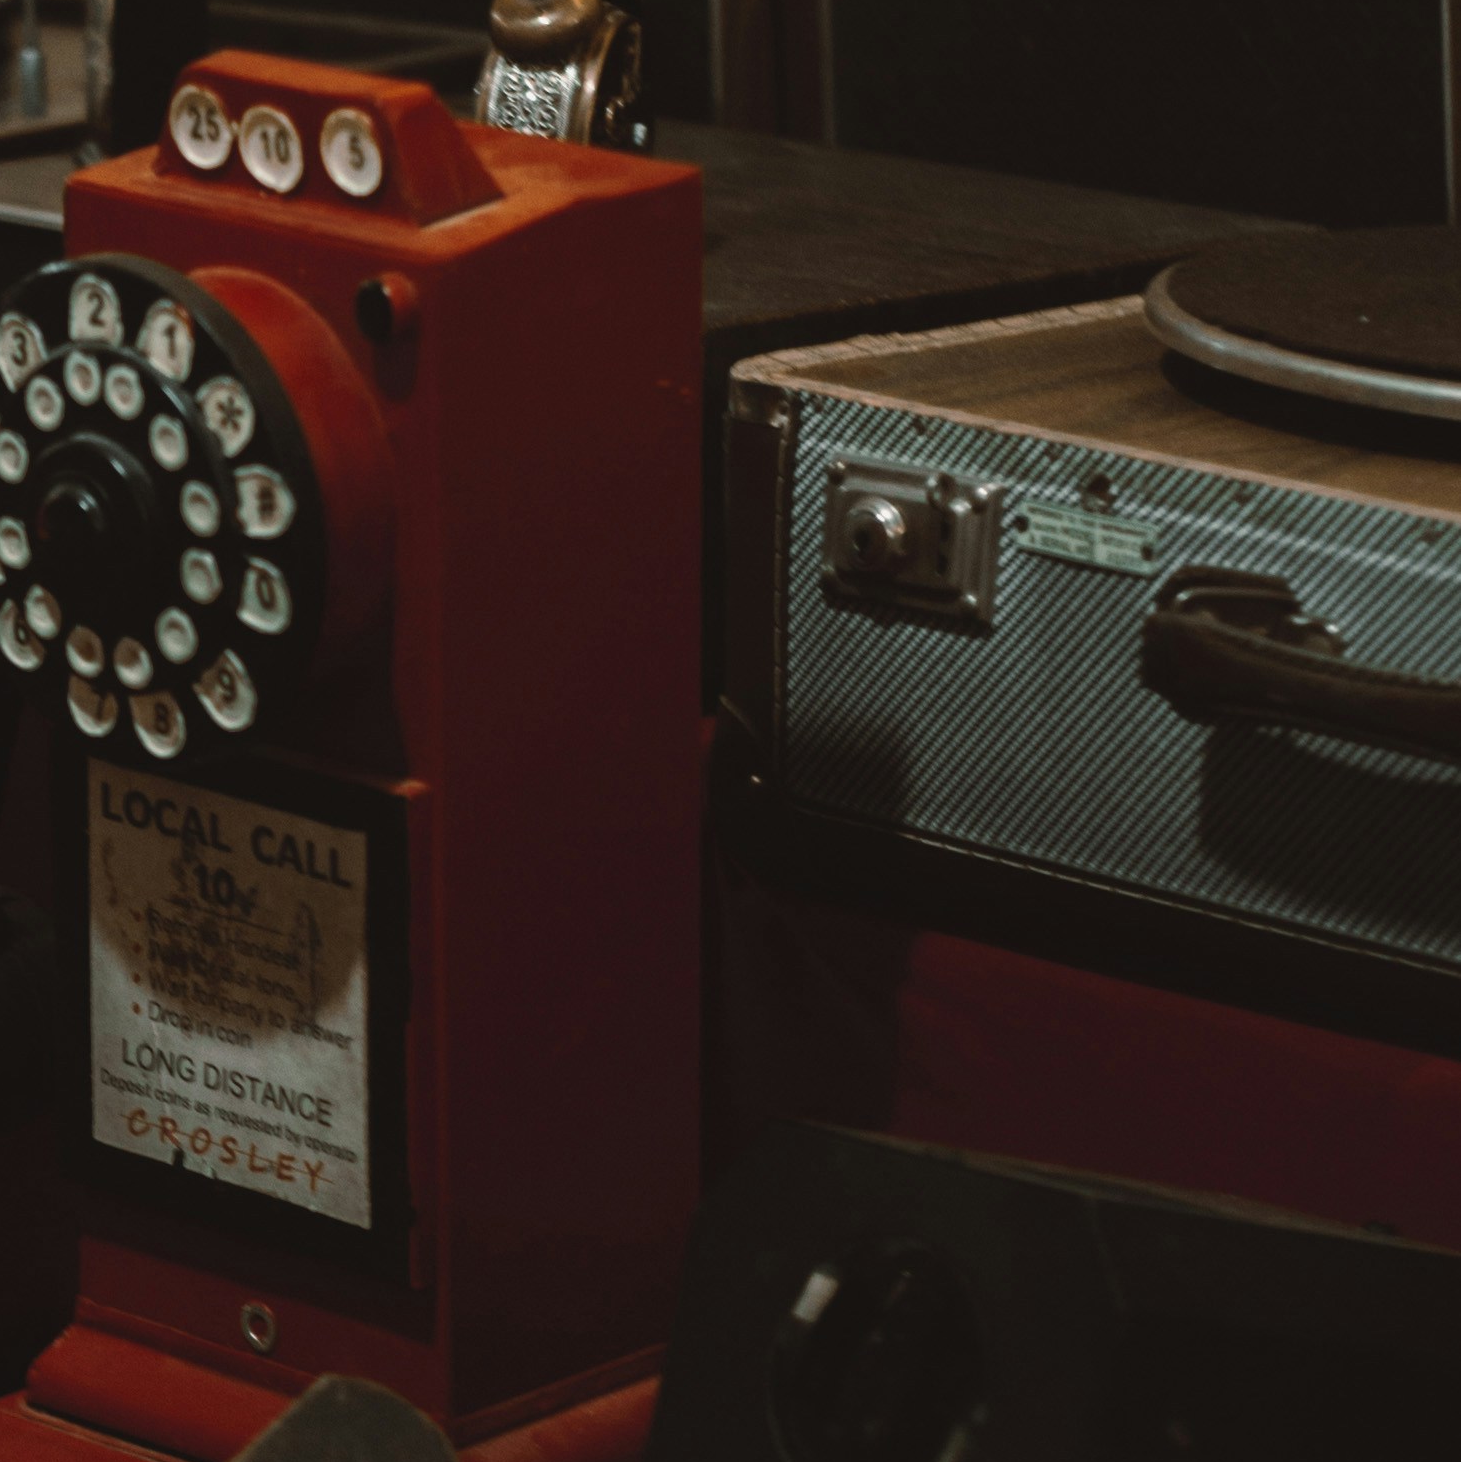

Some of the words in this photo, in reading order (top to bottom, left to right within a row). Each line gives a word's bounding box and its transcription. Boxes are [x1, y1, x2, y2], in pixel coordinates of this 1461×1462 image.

[189, 104, 221, 143] 25
[260, 128, 290, 165] 10
[349, 134, 365, 170] 5
[88, 292, 105, 326] 2
[12, 330, 28, 366] 3
[165, 323, 177, 358] 1
[218, 667, 236, 703] 9
[153, 701, 170, 735] 8
[100, 781, 232, 853] LOCAL
[250, 825, 351, 888] CALL
[147, 999, 192, 1035] Drop
[216, 1020, 252, 1050] coin
[290, 1013, 353, 1052] answer
[121, 1036, 195, 1086] LONG
[202, 1061, 332, 1129] DISTANCE
[100, 1068, 150, 1100] Deposit
[154, 1085, 190, 1112] coins
[213, 1103, 281, 1141] requested
[126, 1108, 325, 1192] CROSLEY
